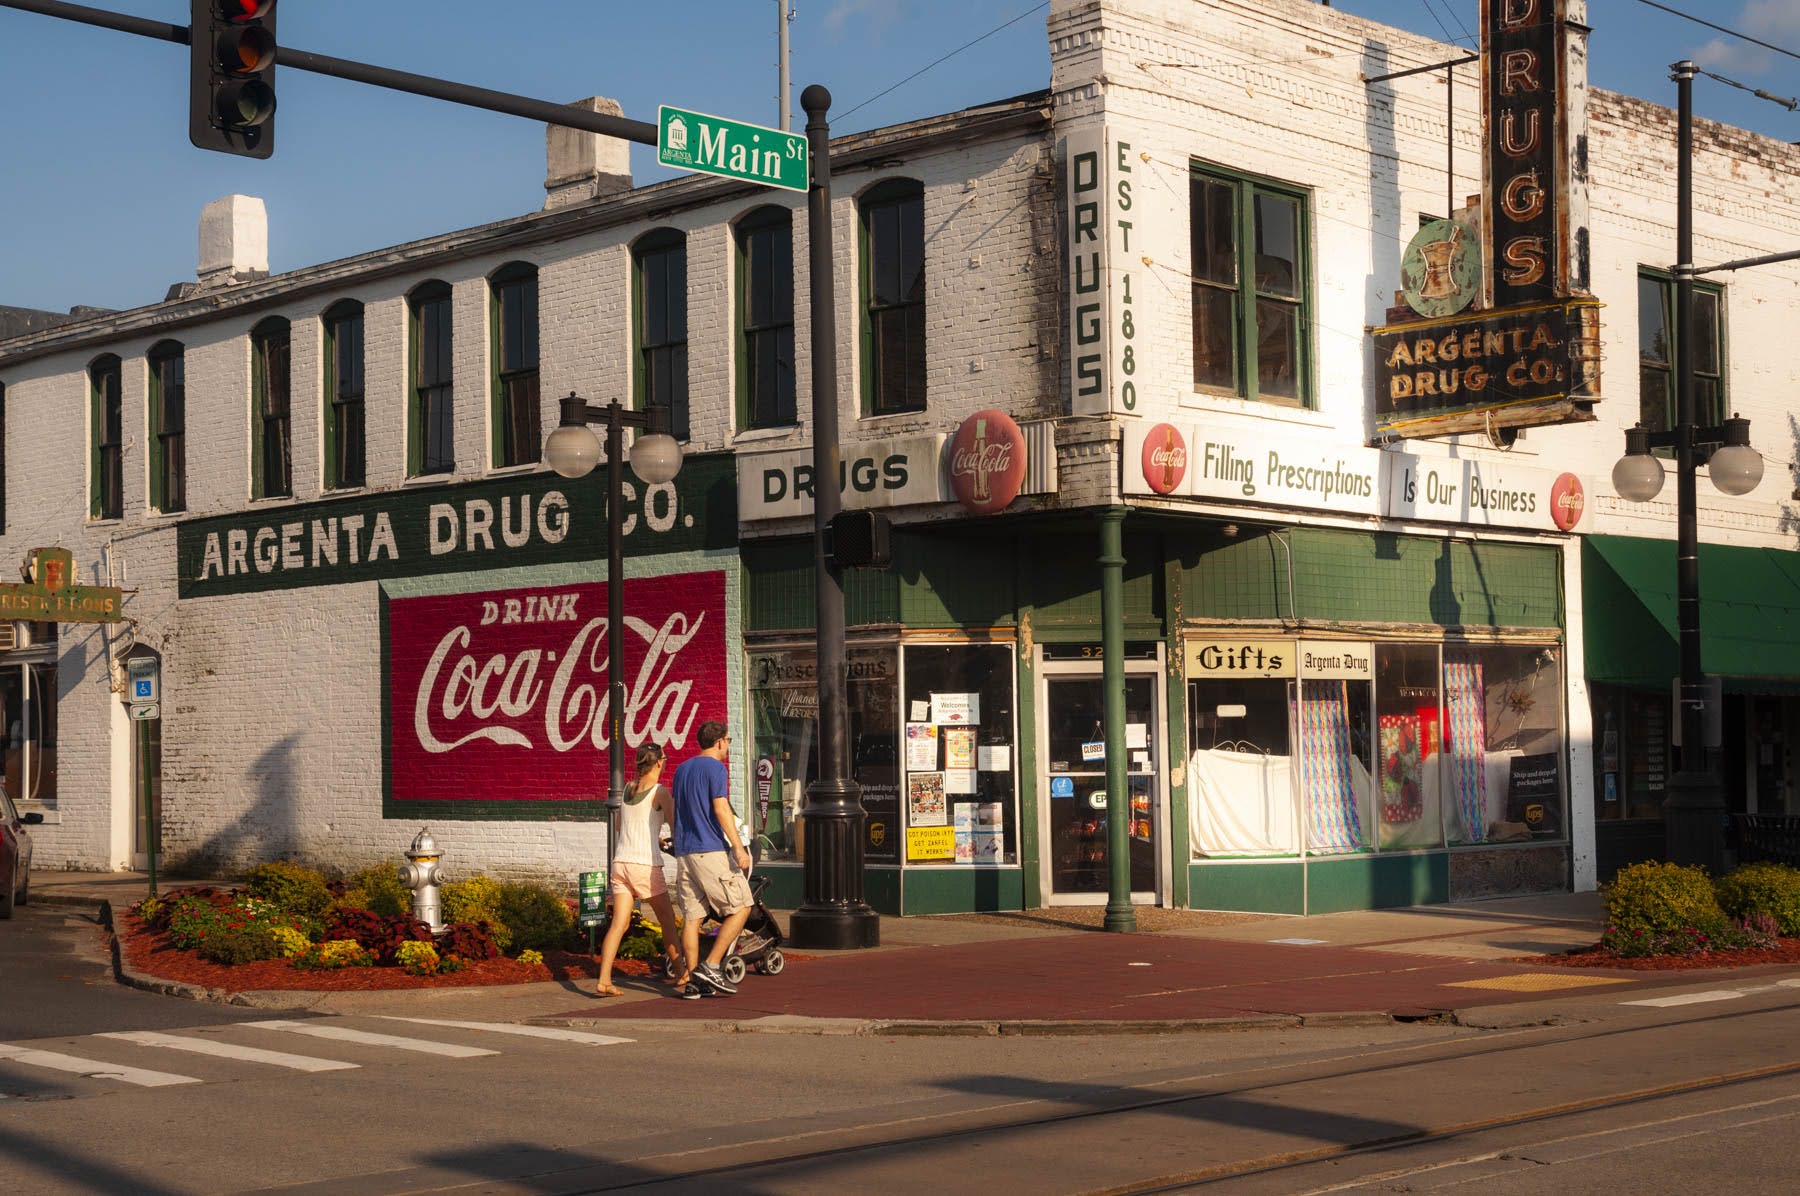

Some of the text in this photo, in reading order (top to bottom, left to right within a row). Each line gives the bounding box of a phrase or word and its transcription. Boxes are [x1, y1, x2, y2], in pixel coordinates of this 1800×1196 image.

[695, 123, 803, 179] Main St
[1499, 0, 1545, 286] DRUGS
[1074, 151, 1102, 397] DRUGS
[1117, 141, 1136, 411] EST 1880
[1388, 323, 1557, 369] ARGENTA
[1390, 365, 1489, 399] DRUG
[763, 454, 909, 504] DRGS
[1204, 442, 1372, 502] Filling Prescriptions
[1403, 468, 1536, 513] Is Our Business
[200, 511, 399, 580] ARGENTA
[428, 490, 571, 556] DRUG
[480, 593, 580, 626] DRINK
[1082, 646, 1104, 658] 32
[1196, 645, 1284, 671] Gifts
[1304, 652, 1369, 673] Argenta Drug
[758, 656, 887, 685] Prescions
[1084, 744, 1103, 754] CLOSED
[759, 780, 772, 801] LITTLE
[1648, 783, 1664, 791] SALON
[1528, 808, 1543, 821] ups
[871, 829, 884, 843] ups
[920, 830, 940, 838] POISON
